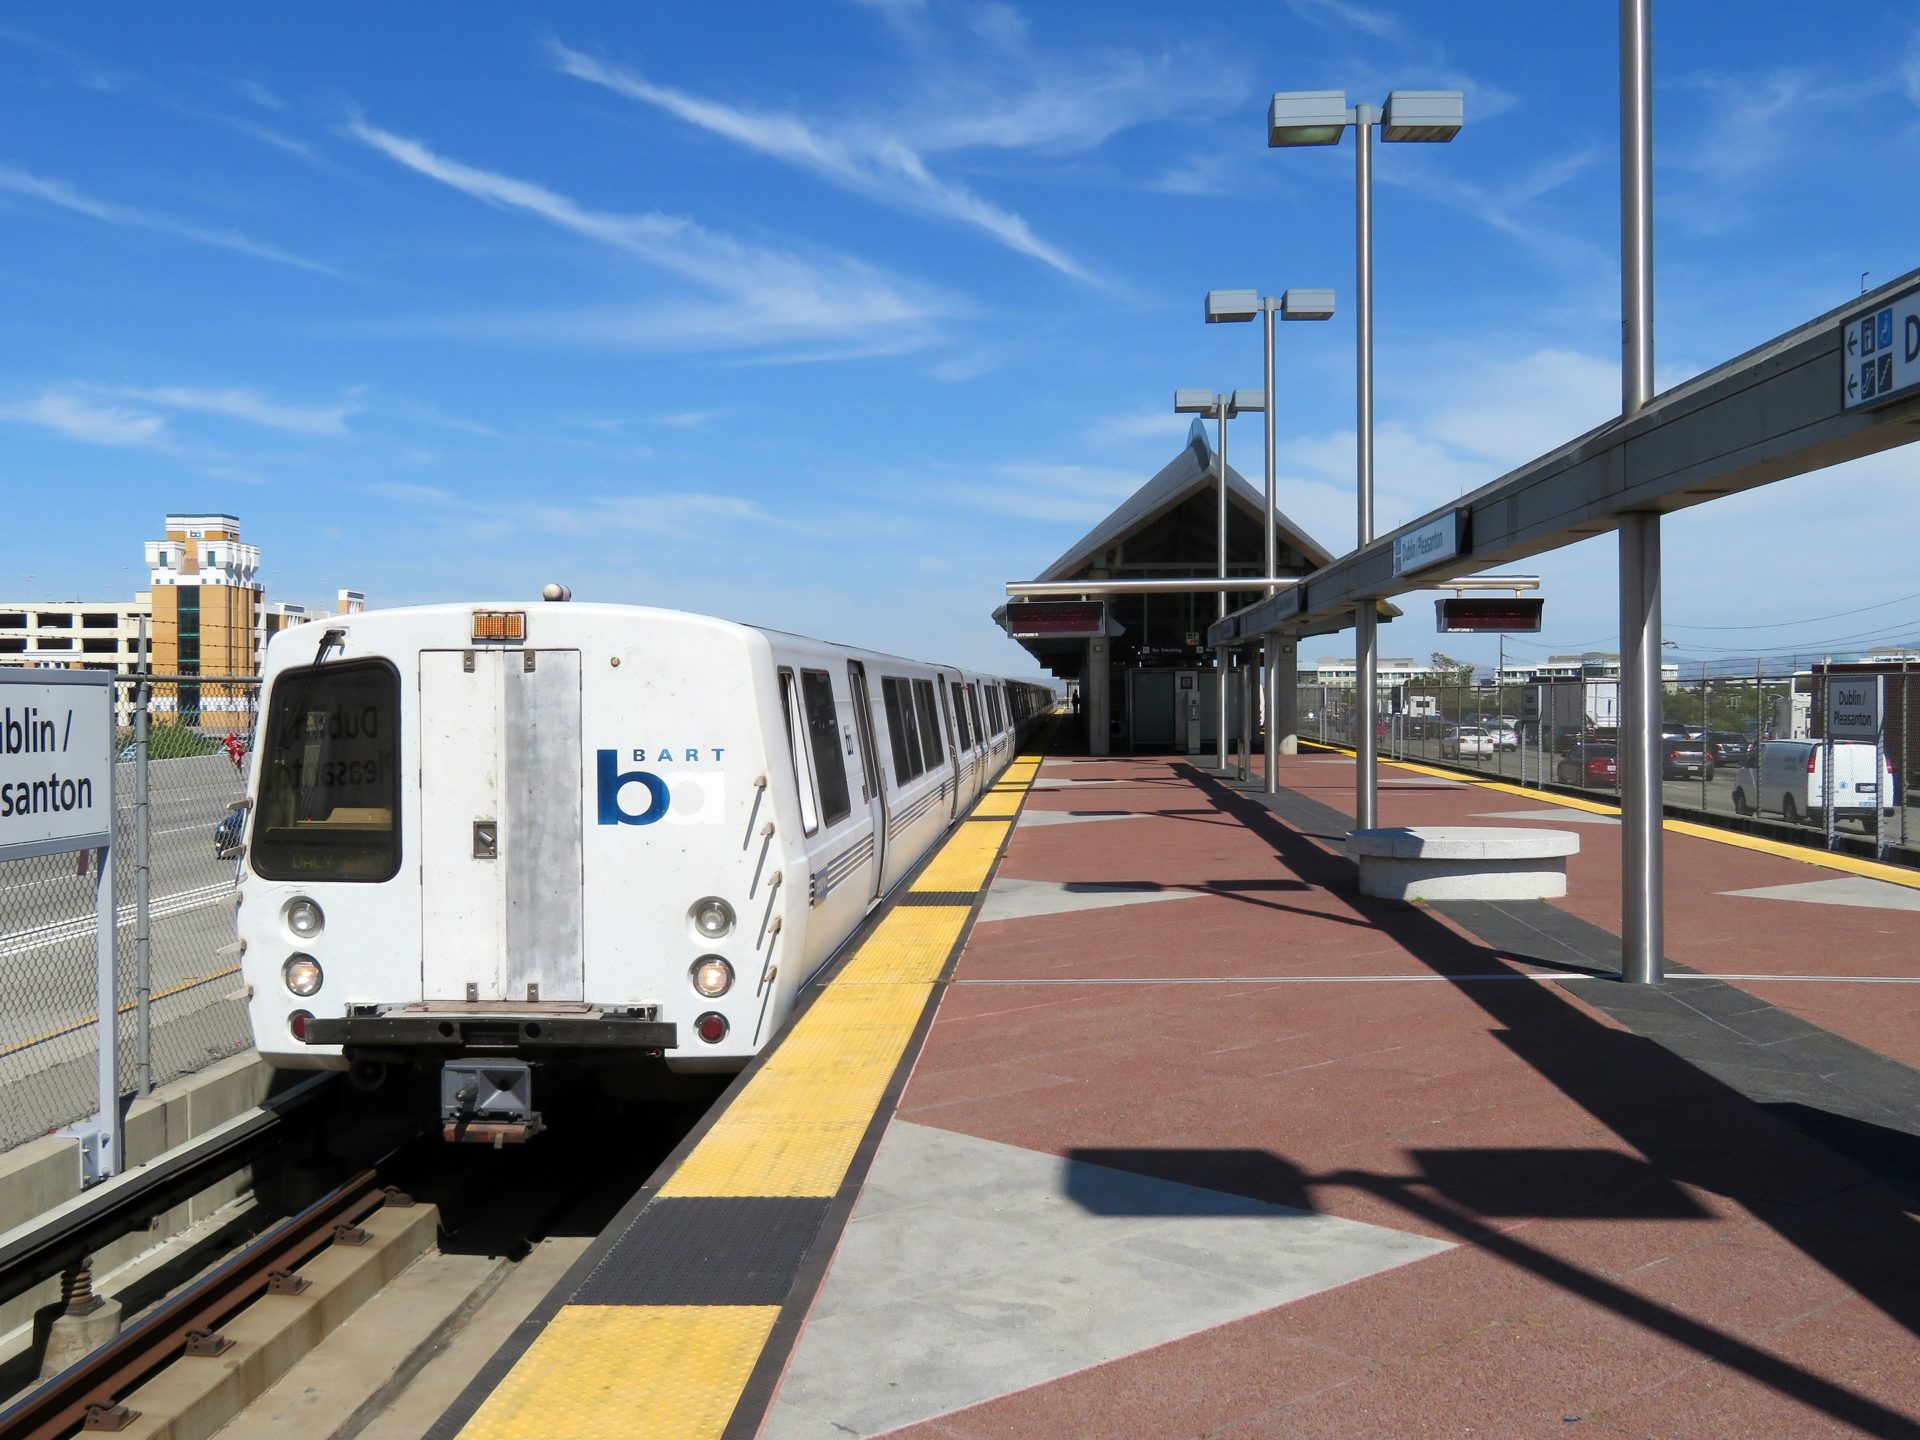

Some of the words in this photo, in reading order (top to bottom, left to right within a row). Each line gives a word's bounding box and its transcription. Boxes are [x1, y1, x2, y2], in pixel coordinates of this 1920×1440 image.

[1838, 689, 1862, 706] Dublin
[1833, 710, 1872, 727] Pleasanton
[0, 707, 56, 754] blin
[633, 748, 725, 762] BART
[1, 772, 92, 817] santon
